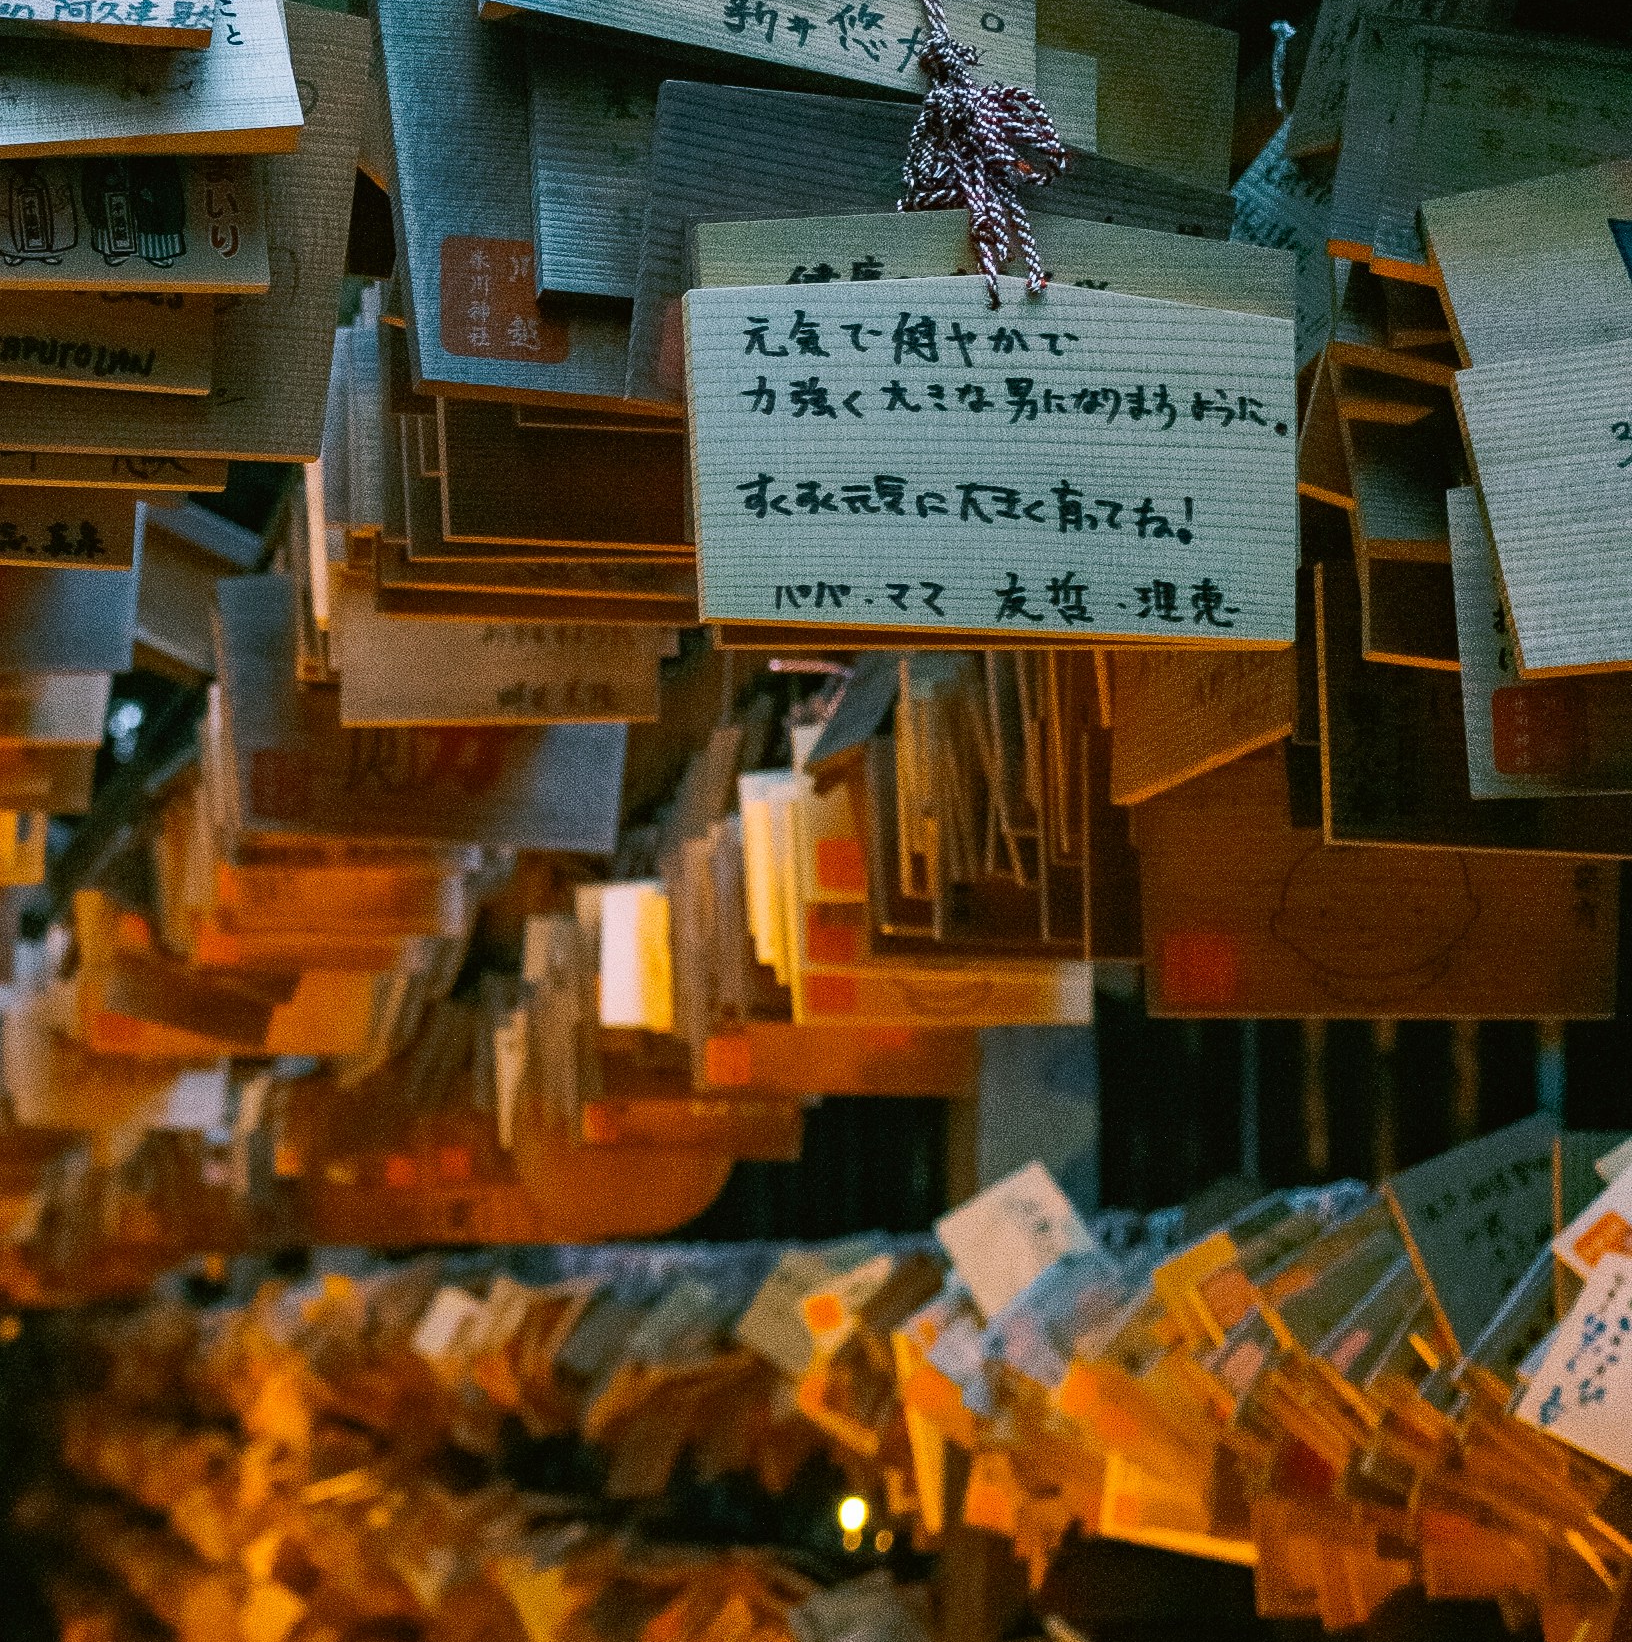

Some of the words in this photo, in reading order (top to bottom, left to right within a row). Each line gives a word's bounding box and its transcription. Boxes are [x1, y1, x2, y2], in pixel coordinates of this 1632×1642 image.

[742, 308, 1079, 369] 元気で健やかで
